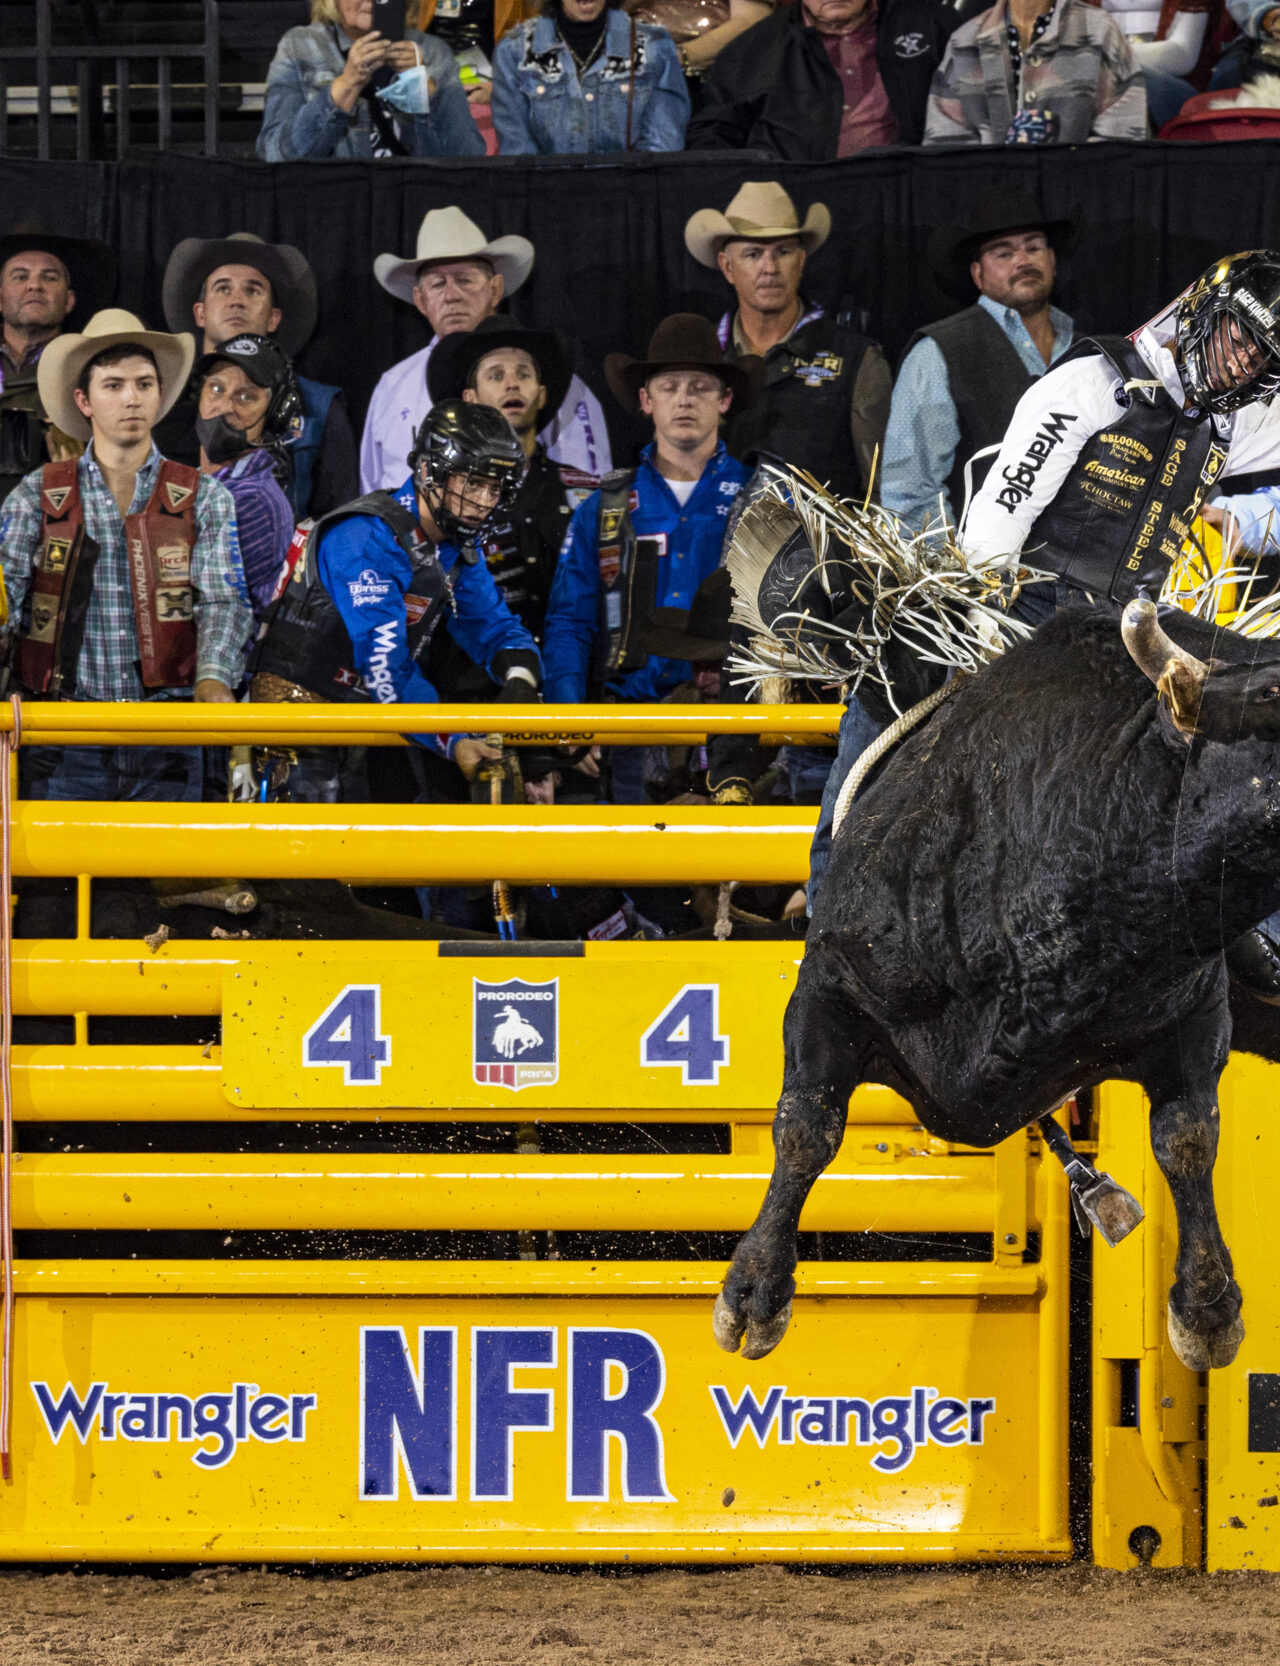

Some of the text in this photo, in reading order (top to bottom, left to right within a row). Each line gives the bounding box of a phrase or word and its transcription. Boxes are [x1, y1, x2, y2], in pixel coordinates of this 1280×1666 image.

[996, 412, 1078, 514] Wrangler
[1084, 461, 1147, 487] American
[1085, 482, 1133, 510] CHOCTAW
[1161, 439, 1187, 487] SAGE
[131, 538, 148, 601] PHOENIX
[1125, 500, 1163, 572] STEELE
[302, 984, 392, 1086] 4
[478, 991, 554, 1001] PRORODEO
[640, 983, 730, 1085] 4
[30, 1380, 317, 1470] Wrangler
[358, 1326, 678, 1503] NFR
[712, 1385, 995, 1475] Wrangler
